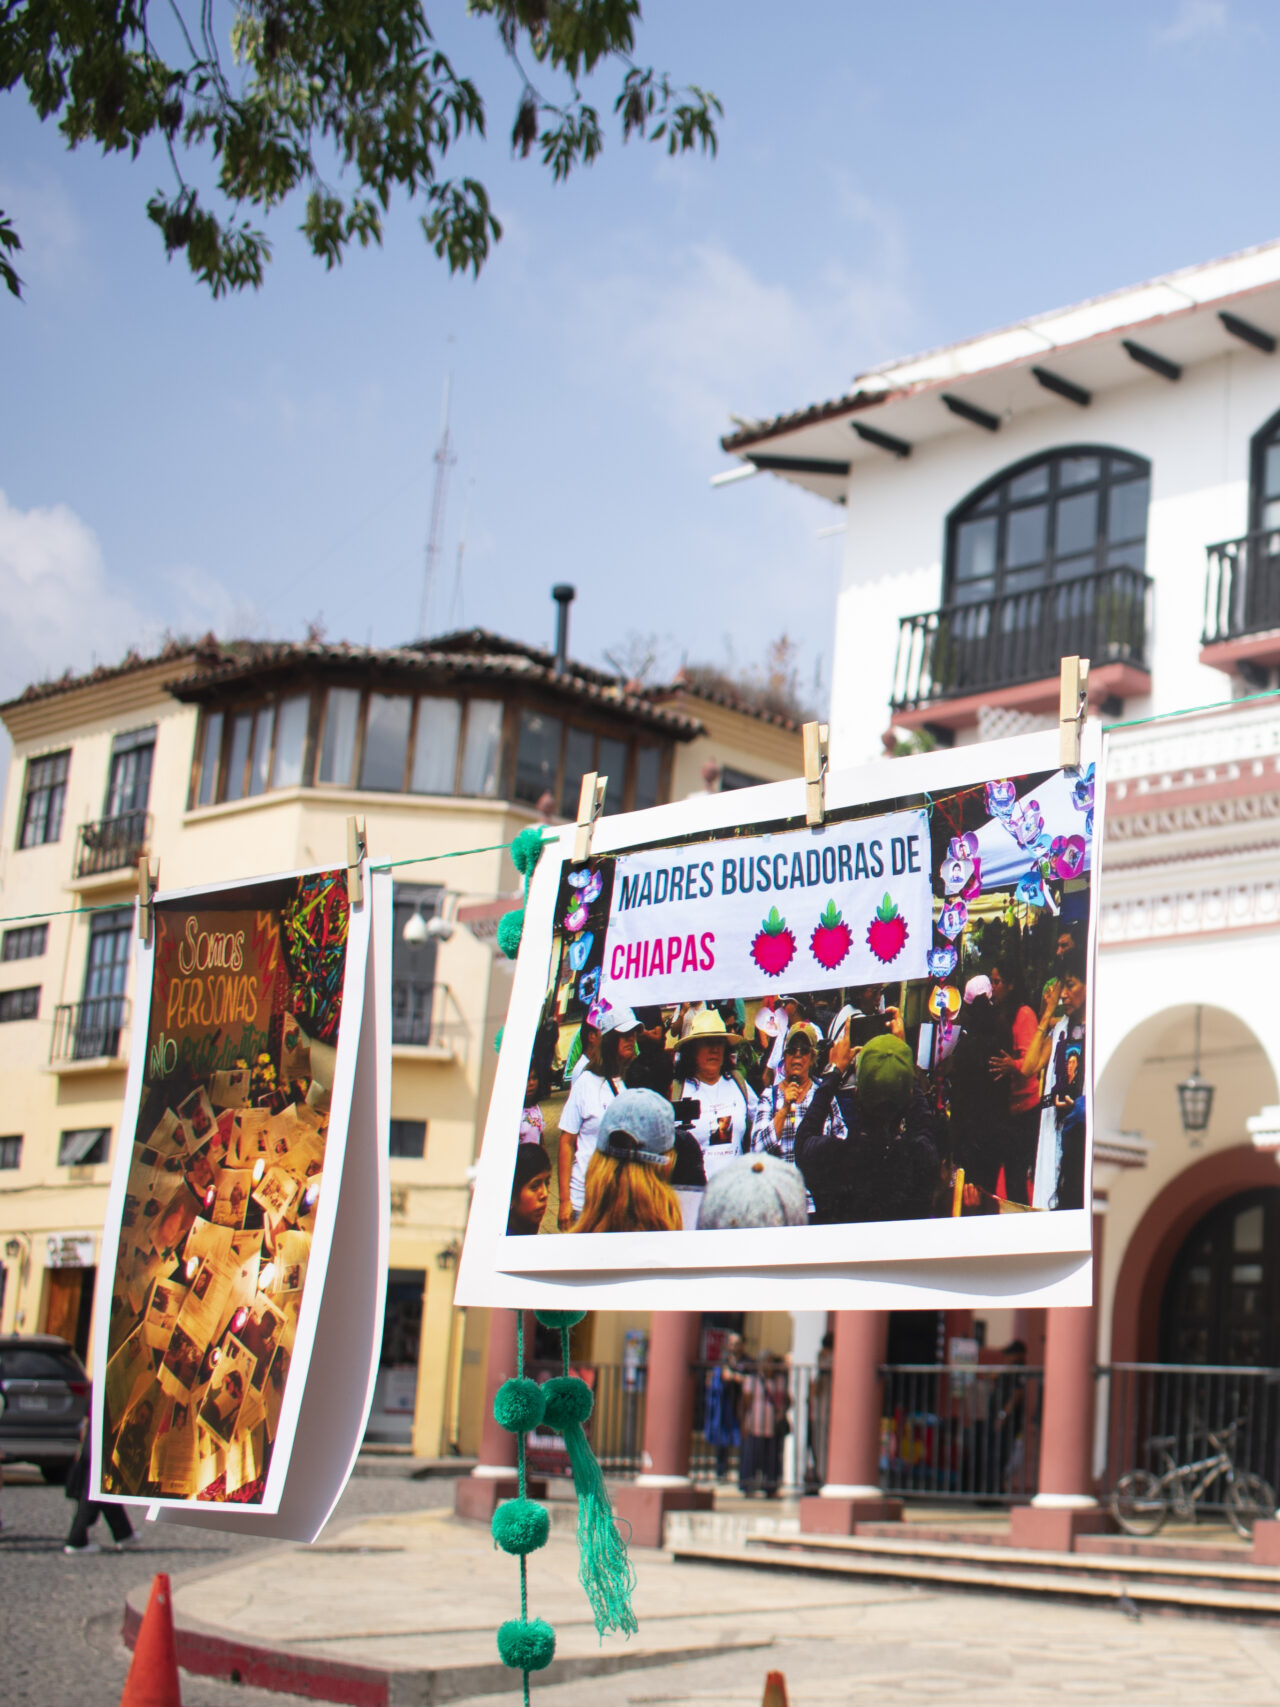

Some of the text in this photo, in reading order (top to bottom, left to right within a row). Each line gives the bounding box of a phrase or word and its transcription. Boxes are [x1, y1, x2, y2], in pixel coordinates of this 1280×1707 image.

[618, 833, 921, 911] MADRES BUSCADORAS DE
[610, 931, 715, 981] CHIAPAS
[166, 975, 258, 1030] PERSONAS
[149, 1032, 178, 1081] NO
